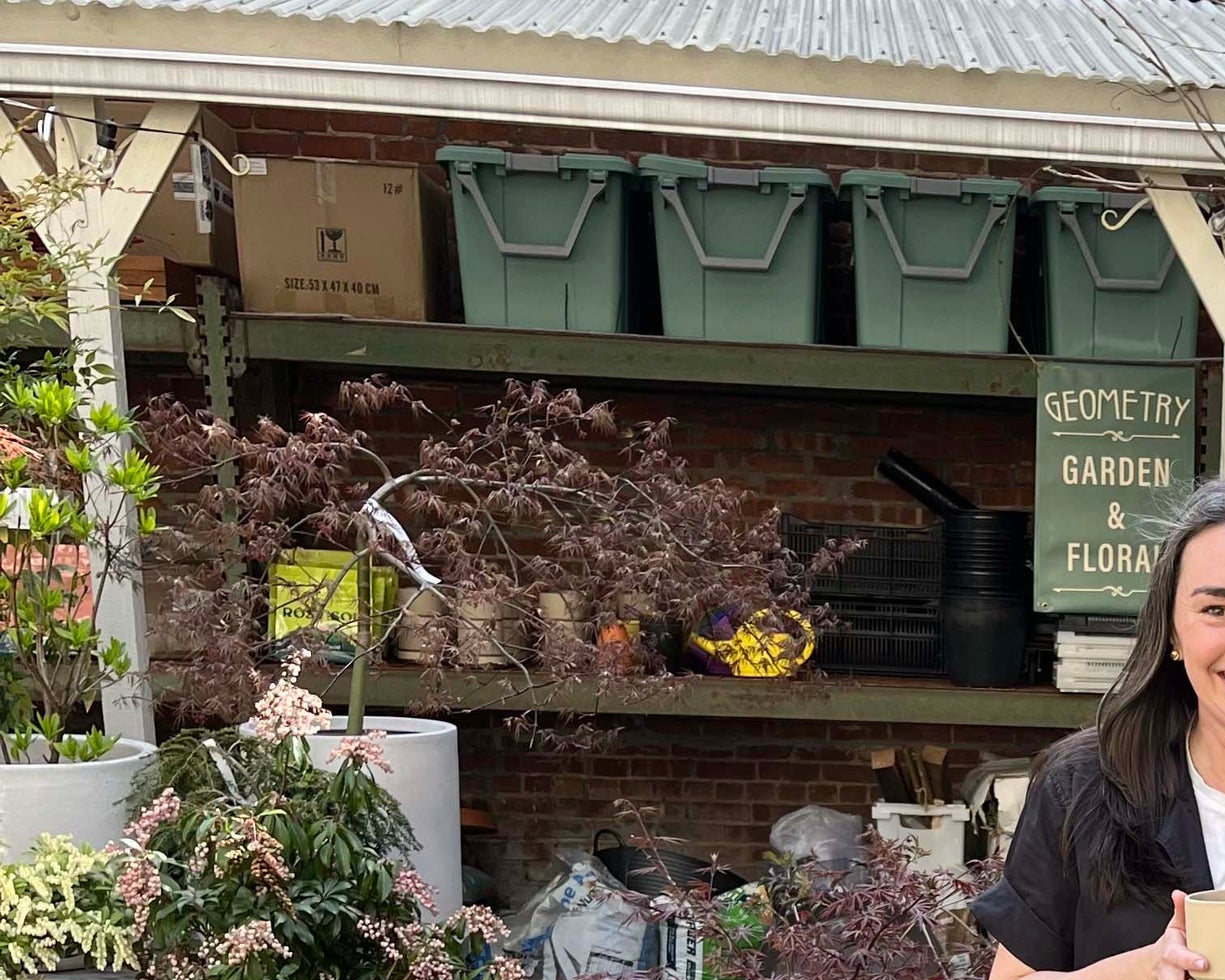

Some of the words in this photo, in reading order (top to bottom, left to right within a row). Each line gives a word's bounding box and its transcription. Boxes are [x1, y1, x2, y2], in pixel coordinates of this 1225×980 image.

[383, 182, 403, 195] 12#
[322, 280, 328, 293] X
[329, 280, 341, 293] 47
[342, 281, 349, 294] X
[350, 282, 363, 295] 40
[365, 282, 380, 296] CM
[1044, 388, 1192, 427] GEOMETRY
[1062, 454, 1170, 487] GARDEN
[1107, 501, 1126, 530] &
[1067, 542, 1158, 574] FLORA
